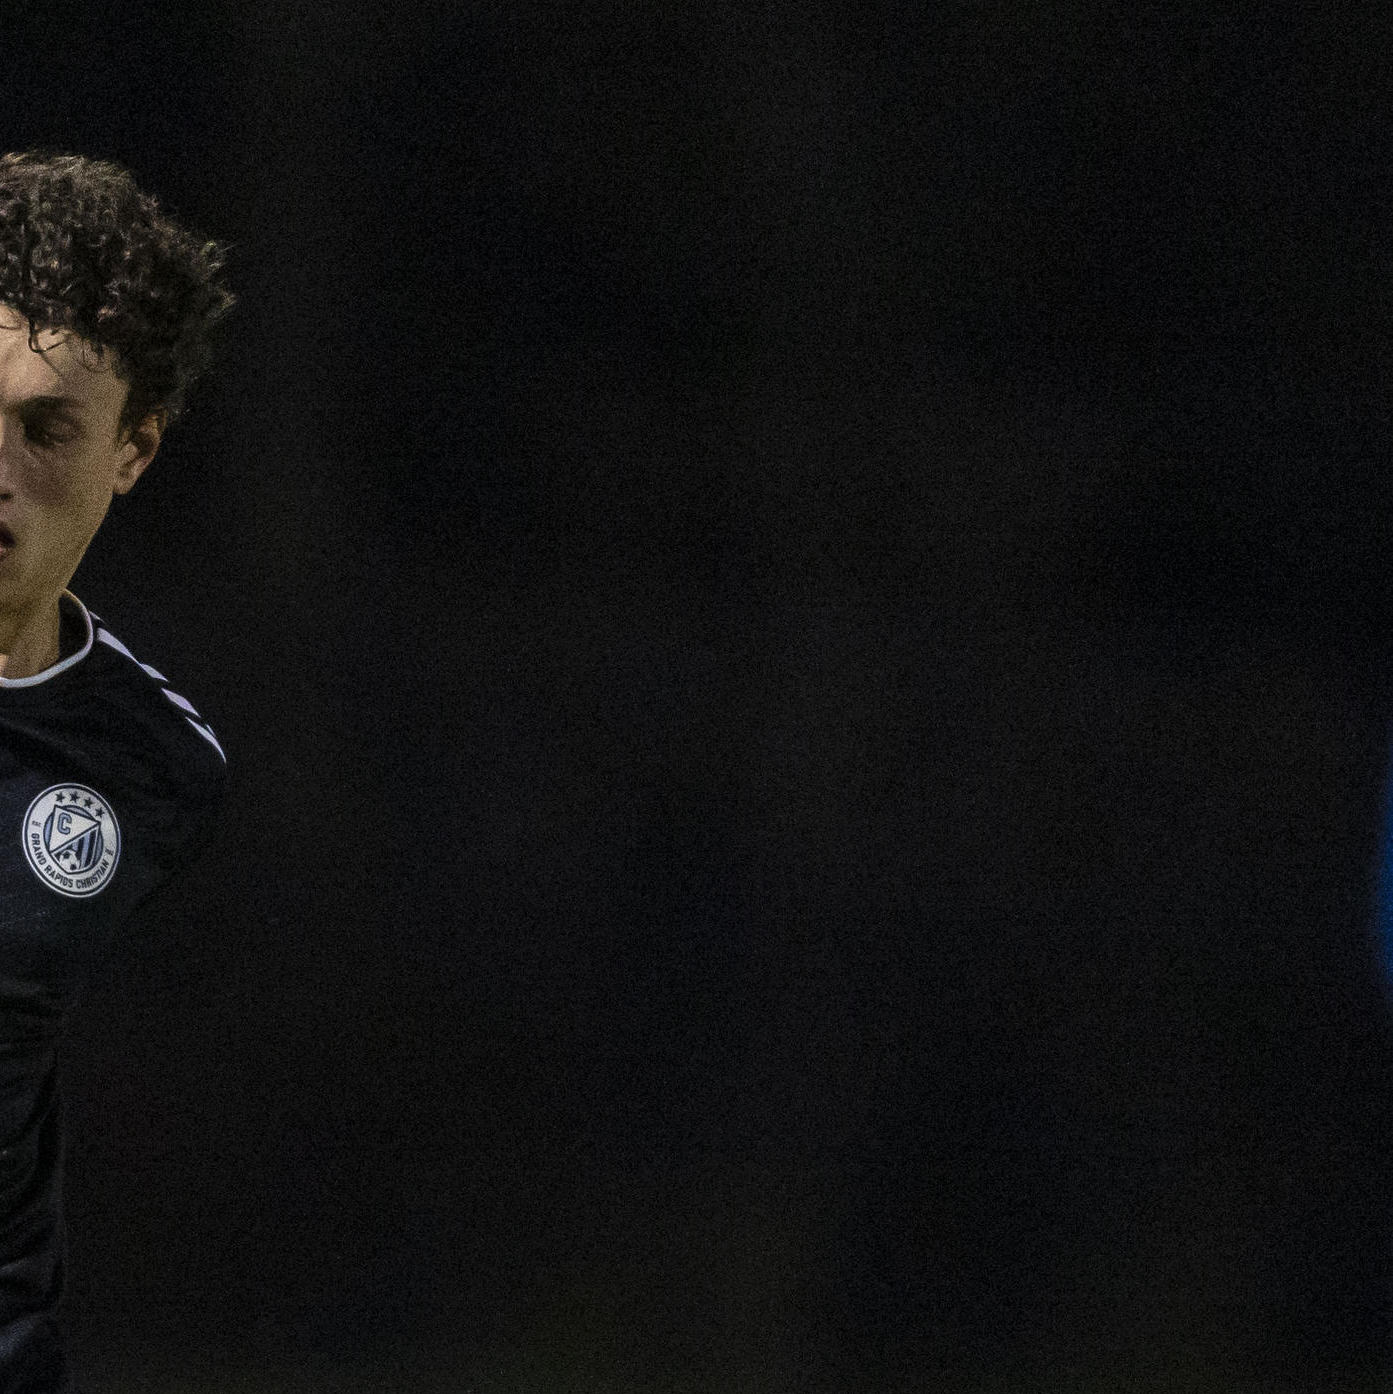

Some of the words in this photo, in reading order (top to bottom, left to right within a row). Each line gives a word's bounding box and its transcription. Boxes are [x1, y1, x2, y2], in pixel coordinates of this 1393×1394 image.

[57, 812, 72, 835] C
[31, 833, 48, 866] GRAND
[44, 865, 74, 887] RAPIDS
[75, 859, 110, 889] CHRISTIAN
